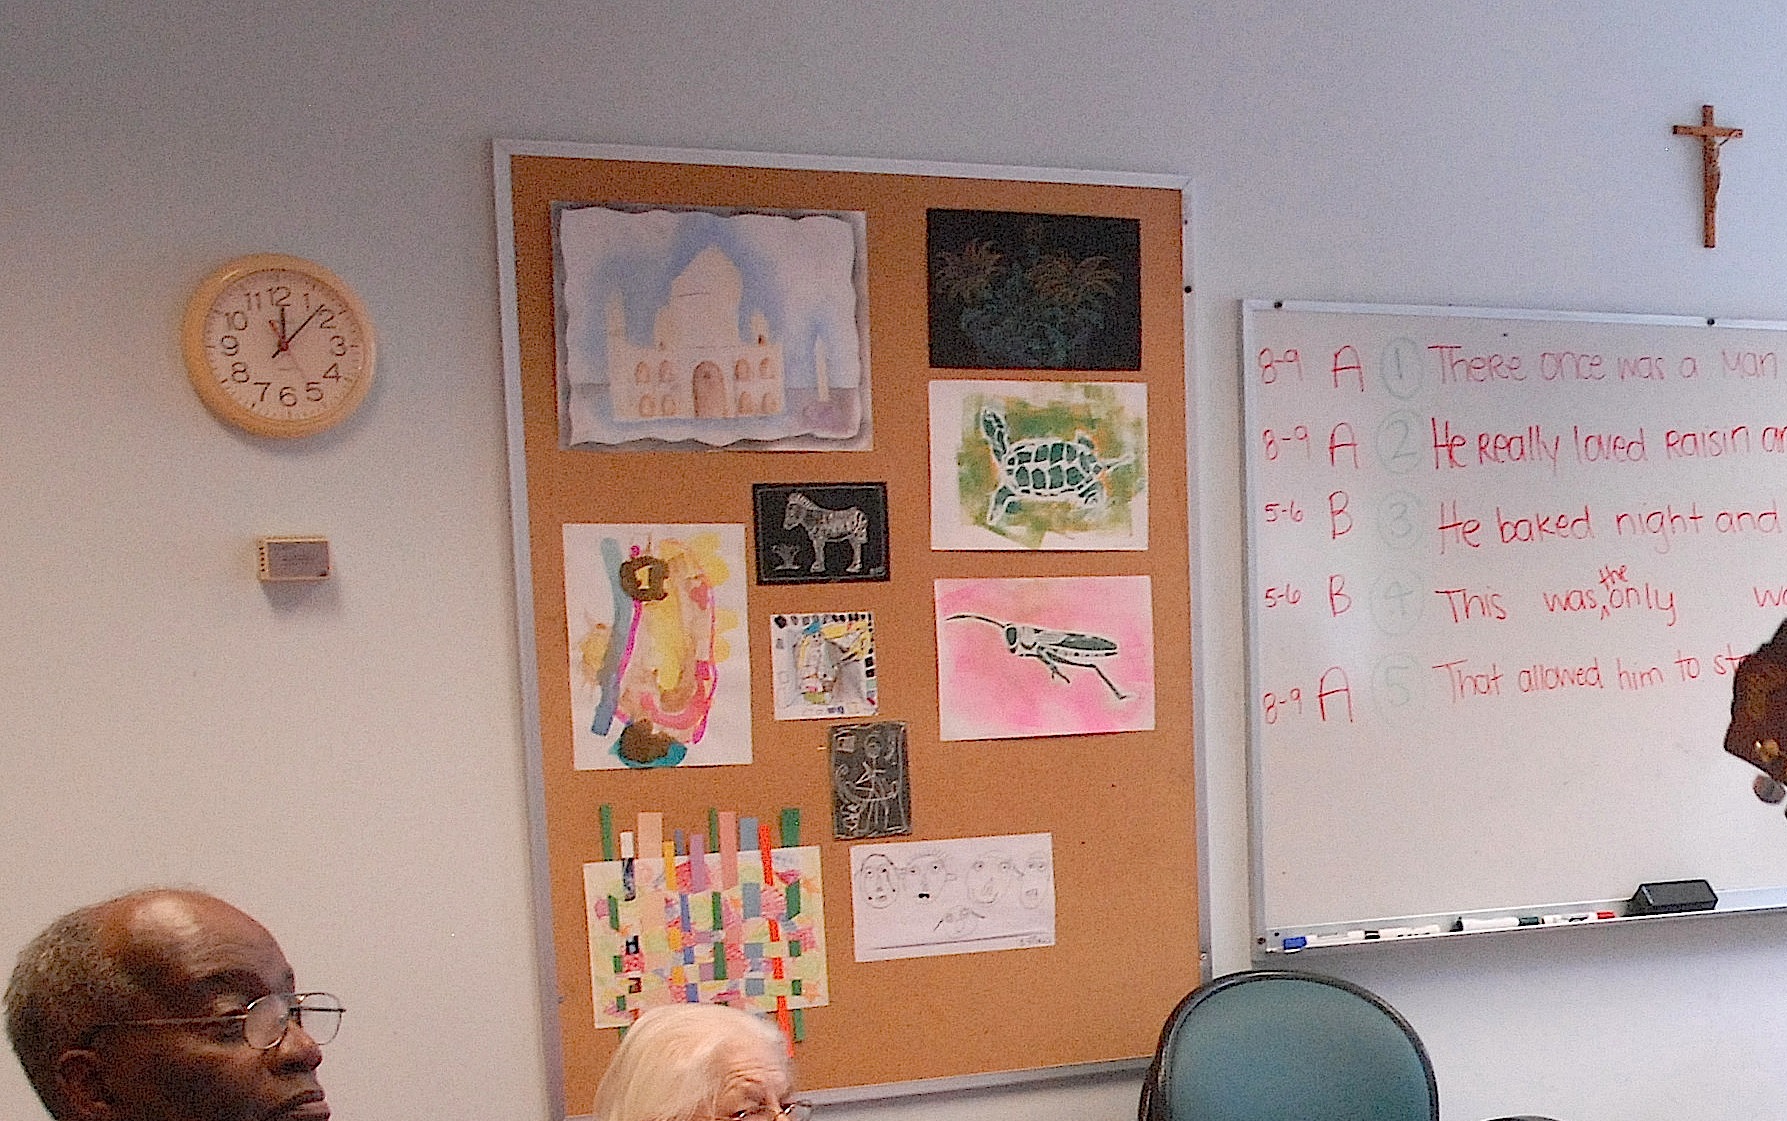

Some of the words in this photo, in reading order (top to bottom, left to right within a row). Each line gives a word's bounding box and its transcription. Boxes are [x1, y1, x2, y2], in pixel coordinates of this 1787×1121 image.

[266, 286, 291, 307] 12
[225, 310, 249, 331] 10
[319, 308, 337, 329] 2
[221, 335, 239, 357] 9
[330, 335, 347, 357] 3
[231, 361, 250, 383] 8
[322, 363, 342, 383] 4
[1330, 344, 1364, 393] A
[1540, 351, 1606, 382] once
[1619, 351, 1667, 383] was
[1682, 355, 1699, 380] a
[253, 382, 271, 402] 7
[279, 386, 297, 407] 6
[306, 382, 324, 402] 5
[1328, 421, 1360, 470] A
[1431, 417, 1467, 470] He
[1573, 424, 1649, 463] loved
[1328, 490, 1354, 540] B
[1438, 501, 1481, 555] He
[1495, 505, 1595, 543] baked
[1616, 505, 1705, 555] night
[1715, 500, 1782, 535] and
[1599, 564, 1628, 587] the
[1328, 574, 1353, 618] B
[1434, 588, 1508, 624] This
[1542, 587, 1597, 613] was
[1609, 581, 1678, 627] only
[1317, 665, 1353, 723] A
[1431, 660, 1504, 703] That
[1518, 657, 1605, 693] allowed
[1617, 663, 1666, 690] him
[1672, 650, 1701, 680] to
